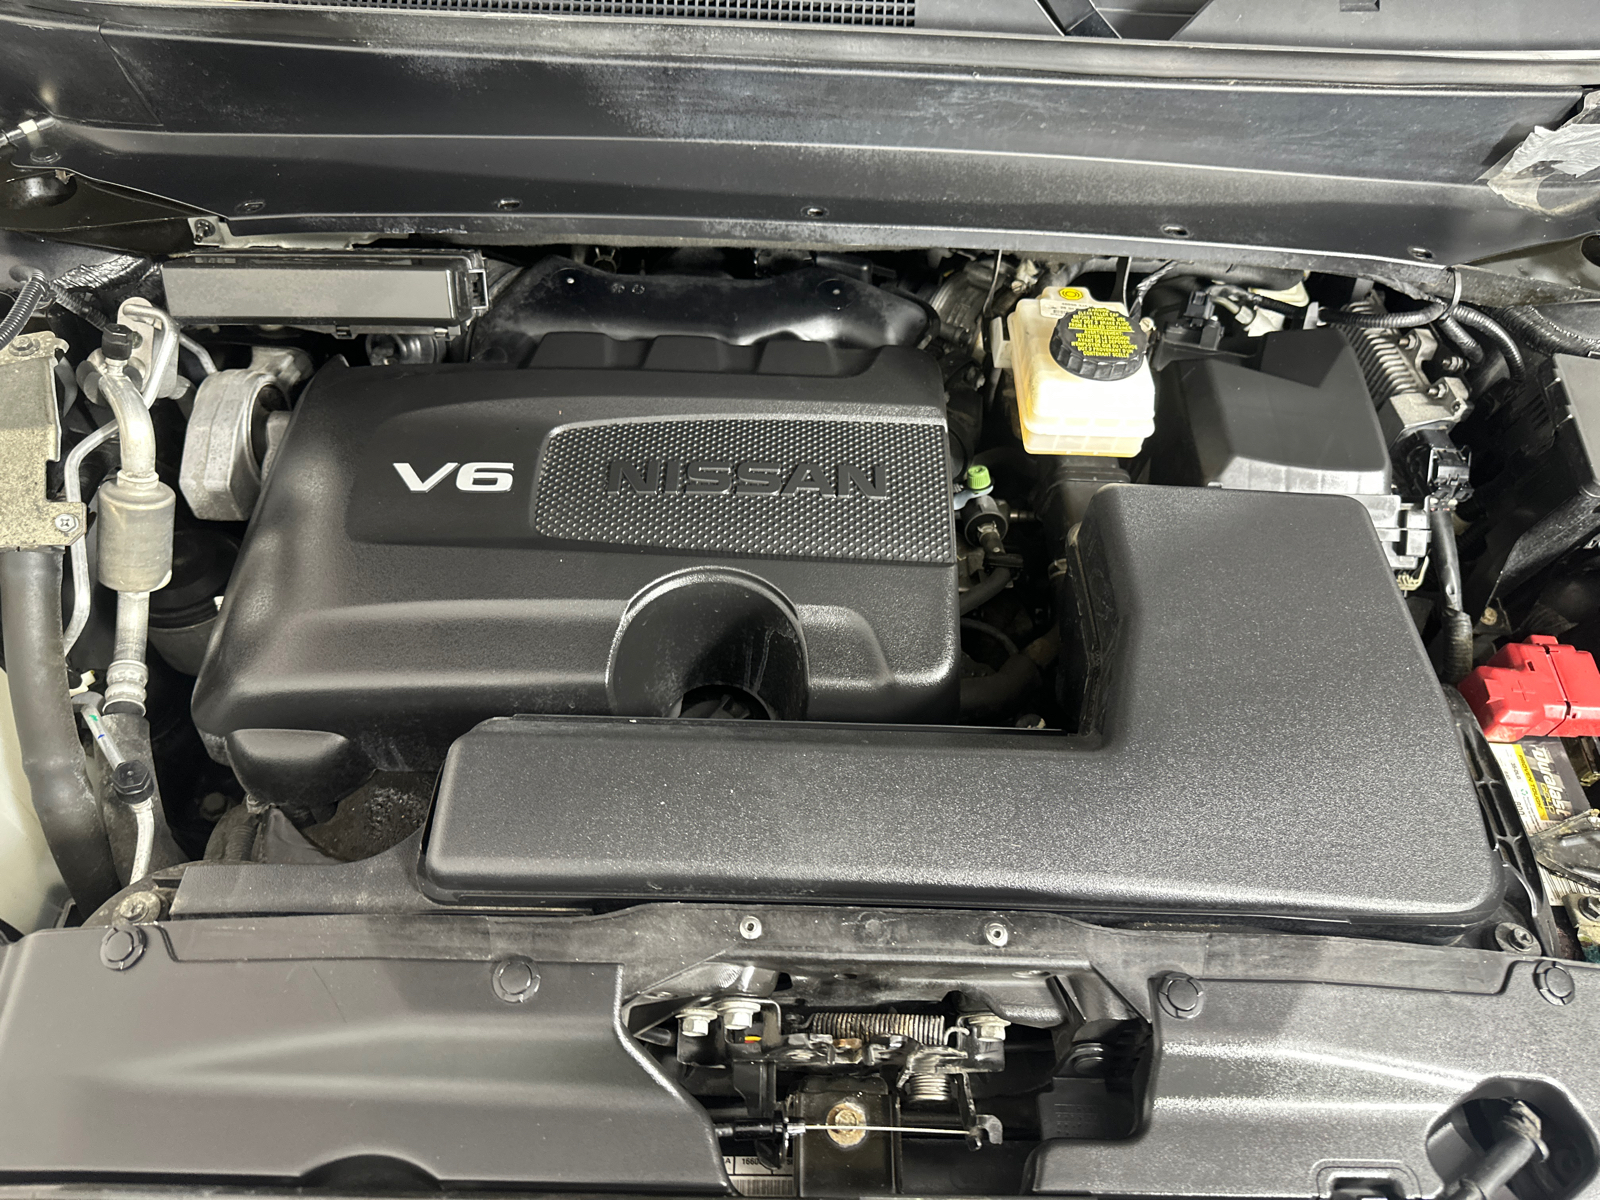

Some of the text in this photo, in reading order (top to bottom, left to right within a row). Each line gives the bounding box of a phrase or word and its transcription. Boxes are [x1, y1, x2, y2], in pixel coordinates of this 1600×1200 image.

[393, 462, 514, 493] V6
[605, 461, 890, 499] NISSAN
[1518, 754, 1533, 784] PROVEN
[1529, 744, 1572, 817] Duralast
[1540, 782, 1556, 814] GOLD
